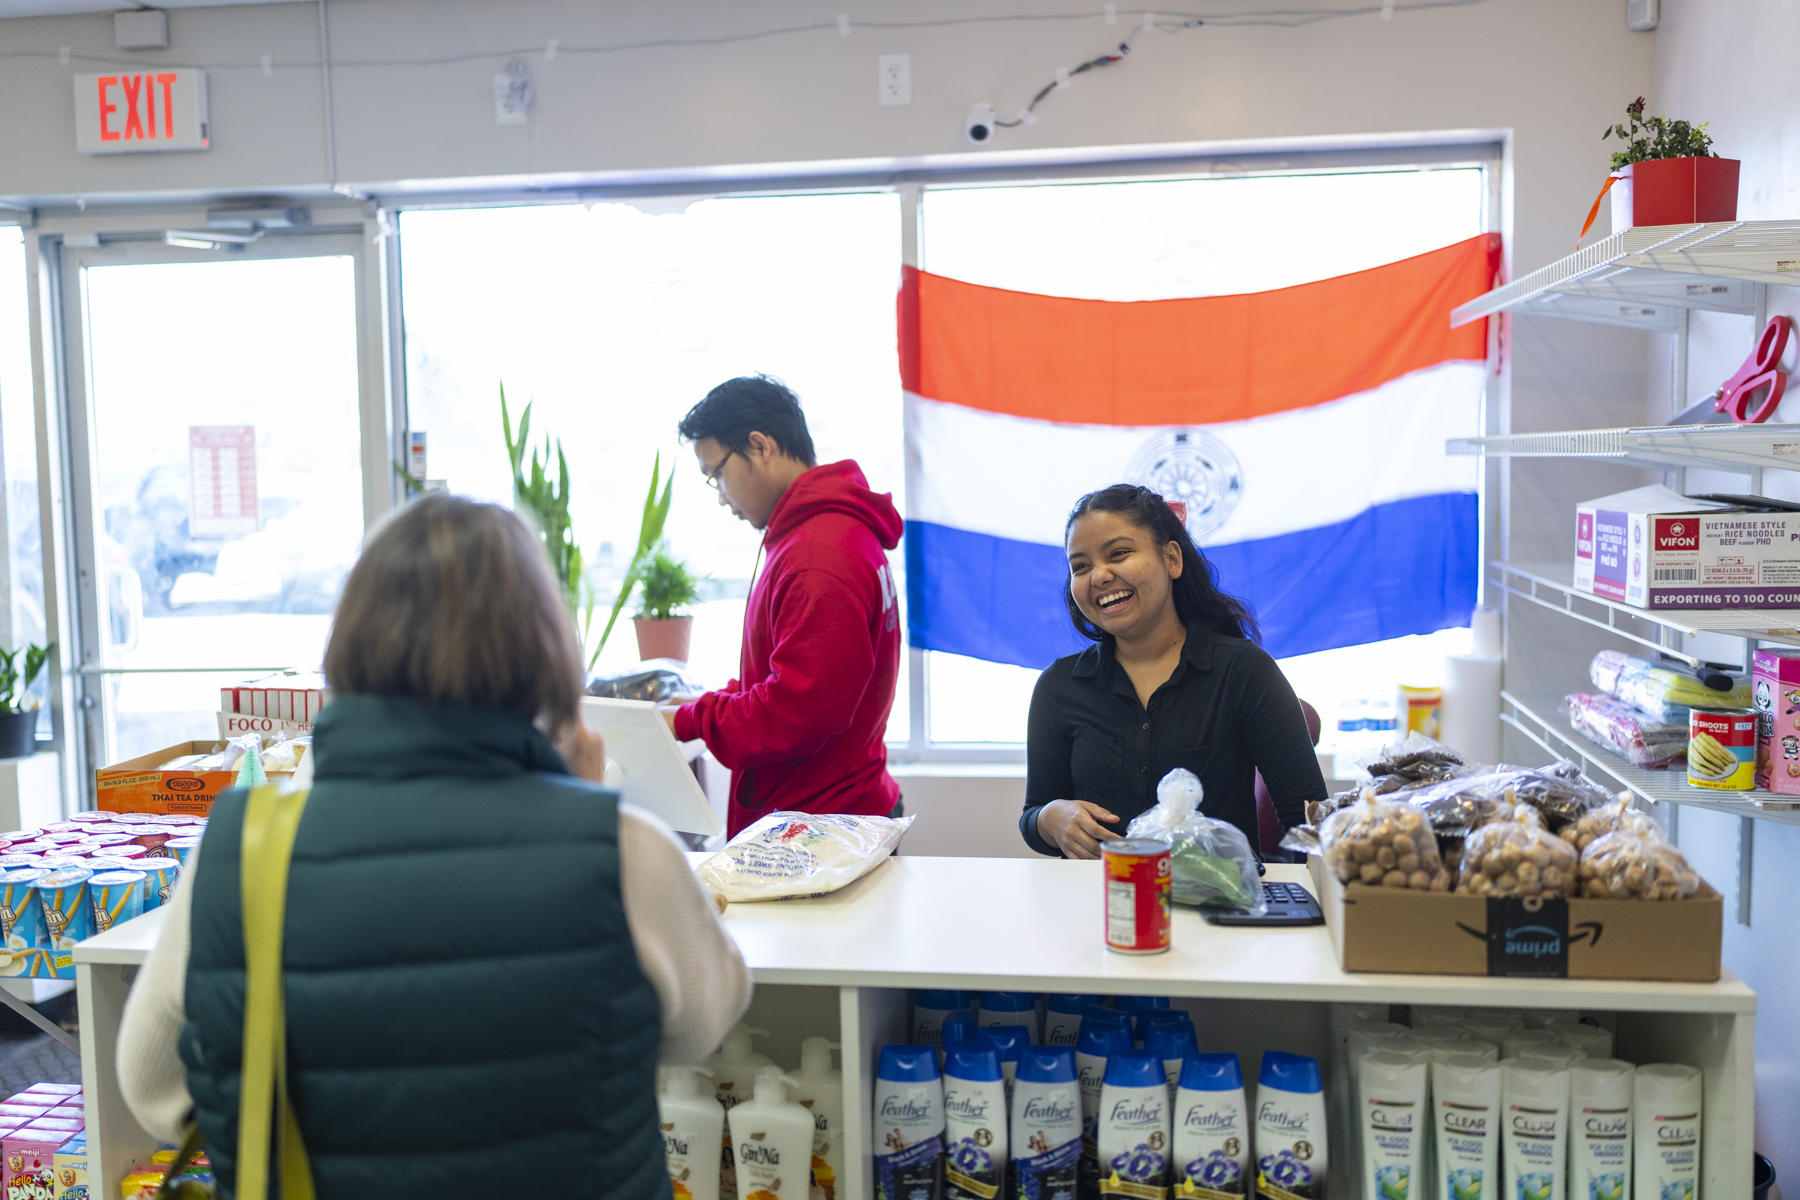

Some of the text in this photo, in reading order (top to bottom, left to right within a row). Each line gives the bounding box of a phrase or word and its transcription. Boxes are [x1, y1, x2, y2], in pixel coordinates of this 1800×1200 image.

[98, 72, 177, 141] EXIT
[1660, 537, 1695, 547] VIFON
[1654, 595, 1721, 604] EXPORTING
[1725, 595, 1740, 603] TO
[1744, 594, 1764, 603] 100
[228, 718, 272, 732] FOCO
[1699, 721, 1728, 730] SHOOTS
[748, 860, 772, 869] SWEET
[1505, 939, 1561, 958] prime
[880, 1095, 931, 1117] Feather
[944, 1090, 988, 1115] Feather
[1023, 1098, 1074, 1119] Feather
[1110, 1099, 1163, 1121] Feather
[1184, 1104, 1237, 1126] Feather
[1444, 1112, 1486, 1129] CLEAR
[9, 1175, 31, 1186] Hello
[7, 1183, 54, 1200] PANDA
[60, 1188, 84, 1200] Hello
